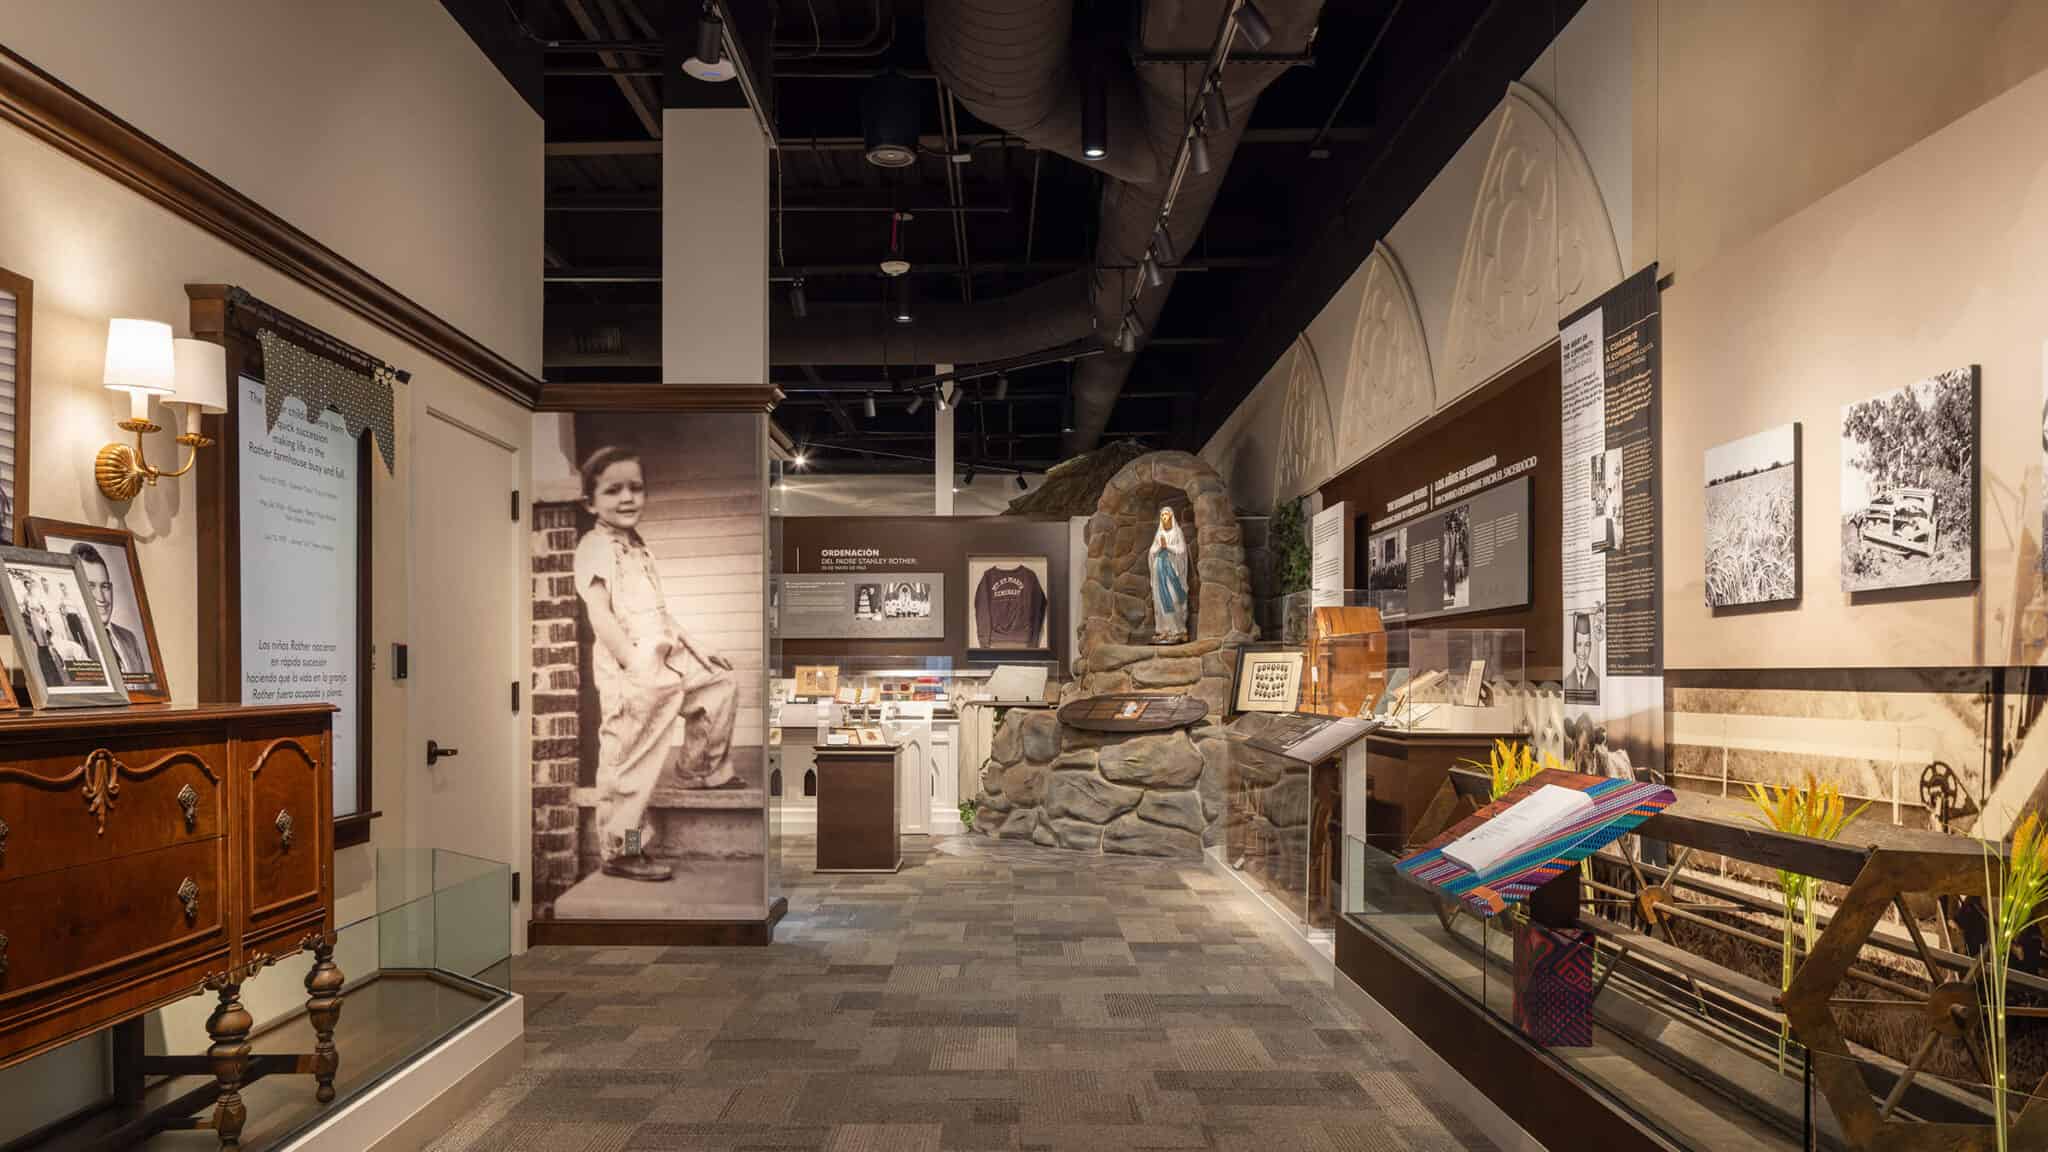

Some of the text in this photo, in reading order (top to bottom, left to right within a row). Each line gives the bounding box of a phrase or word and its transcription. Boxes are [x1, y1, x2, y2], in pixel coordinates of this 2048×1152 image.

[821, 548, 880, 557] ORDENACIÓN
[247, 671, 277, 683] haciendo
[278, 674, 291, 684] que
